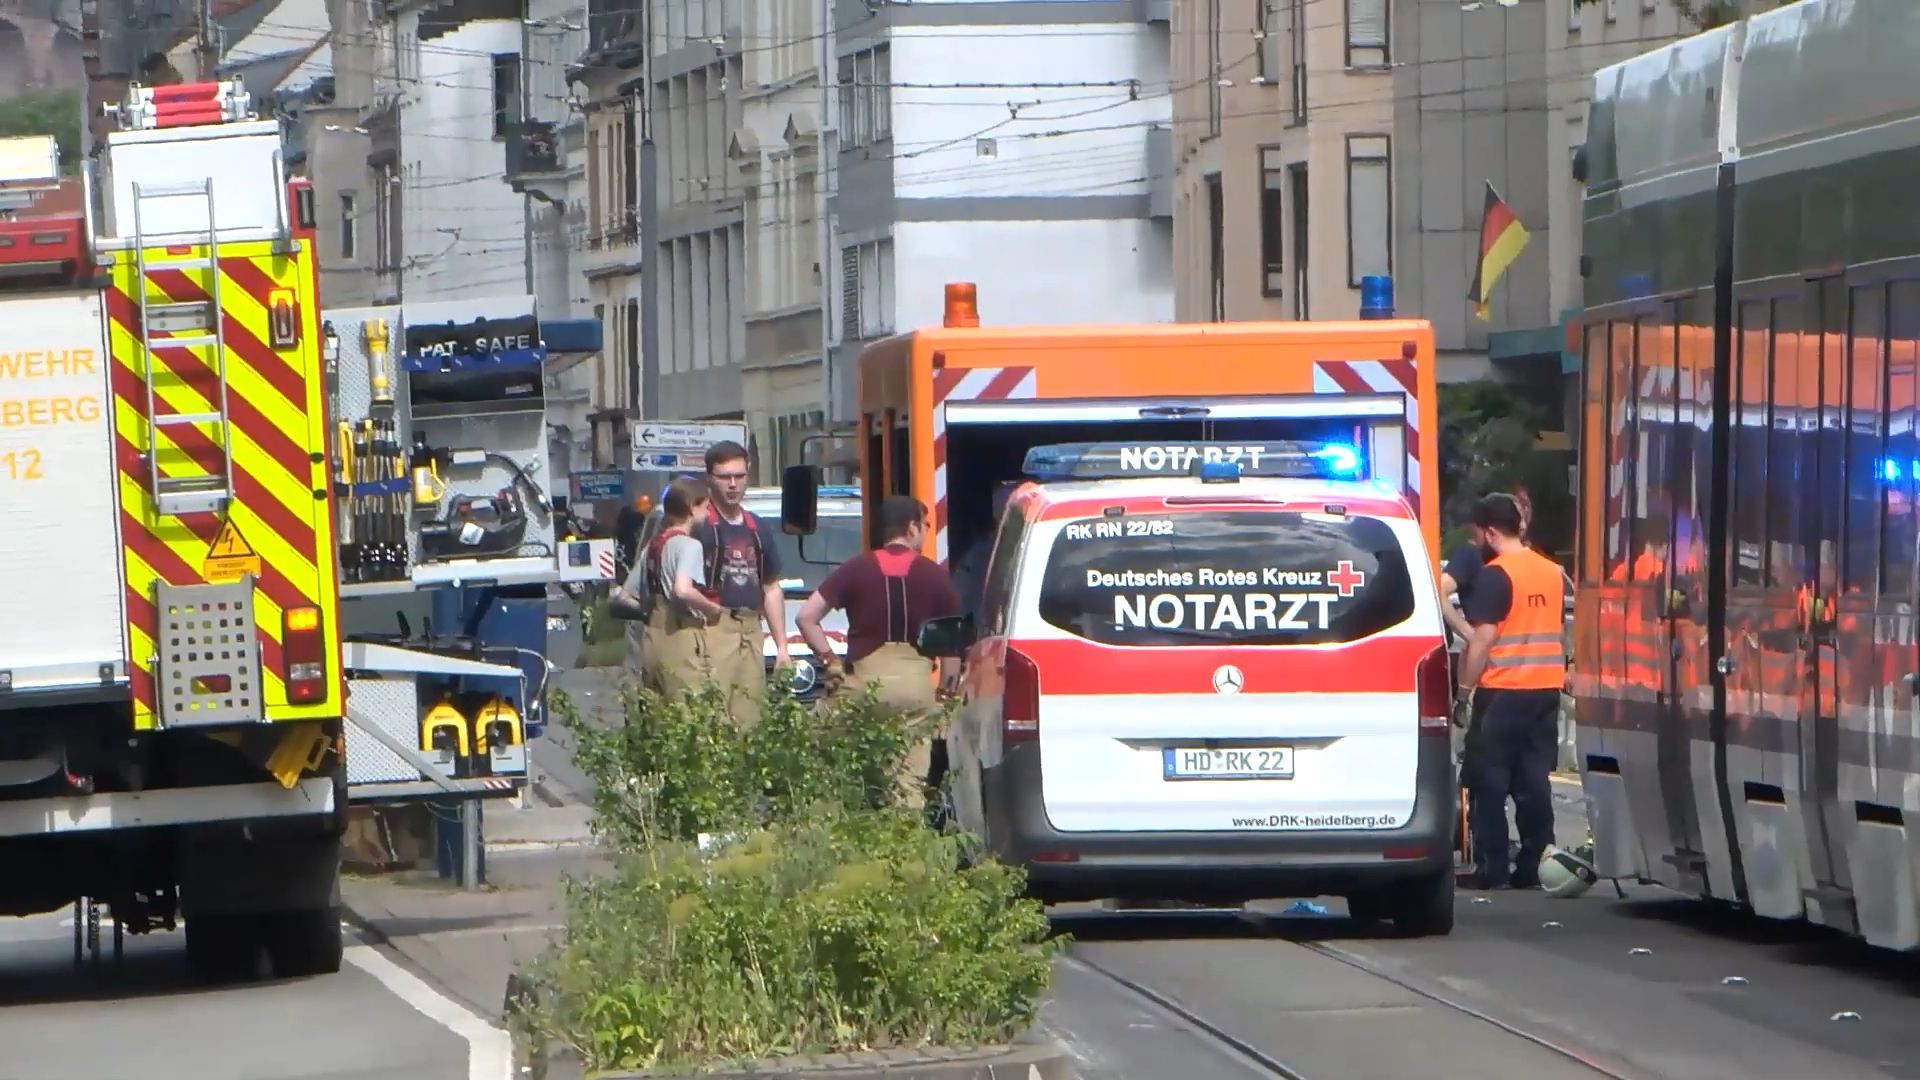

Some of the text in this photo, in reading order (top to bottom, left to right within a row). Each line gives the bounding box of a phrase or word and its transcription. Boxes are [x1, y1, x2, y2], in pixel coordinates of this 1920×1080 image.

[475, 334, 530, 353] SAFE
[0, 348, 95, 379] WEHR
[2, 395, 100, 427] BERG
[3, 448, 43, 480] 12
[1120, 446, 1265, 471] NOTARZT
[1066, 524, 1093, 541] RK
[1095, 521, 1122, 538] RN
[1086, 567, 1322, 588] Deutsches Rotes Kreuz
[1113, 593, 1339, 632] NOTARZT
[1184, 751, 1212, 771] HD
[1225, 750, 1253, 771] RK
[1258, 750, 1285, 771] 22
[1231, 814, 1397, 828] www.DRK-heidelberg.de
